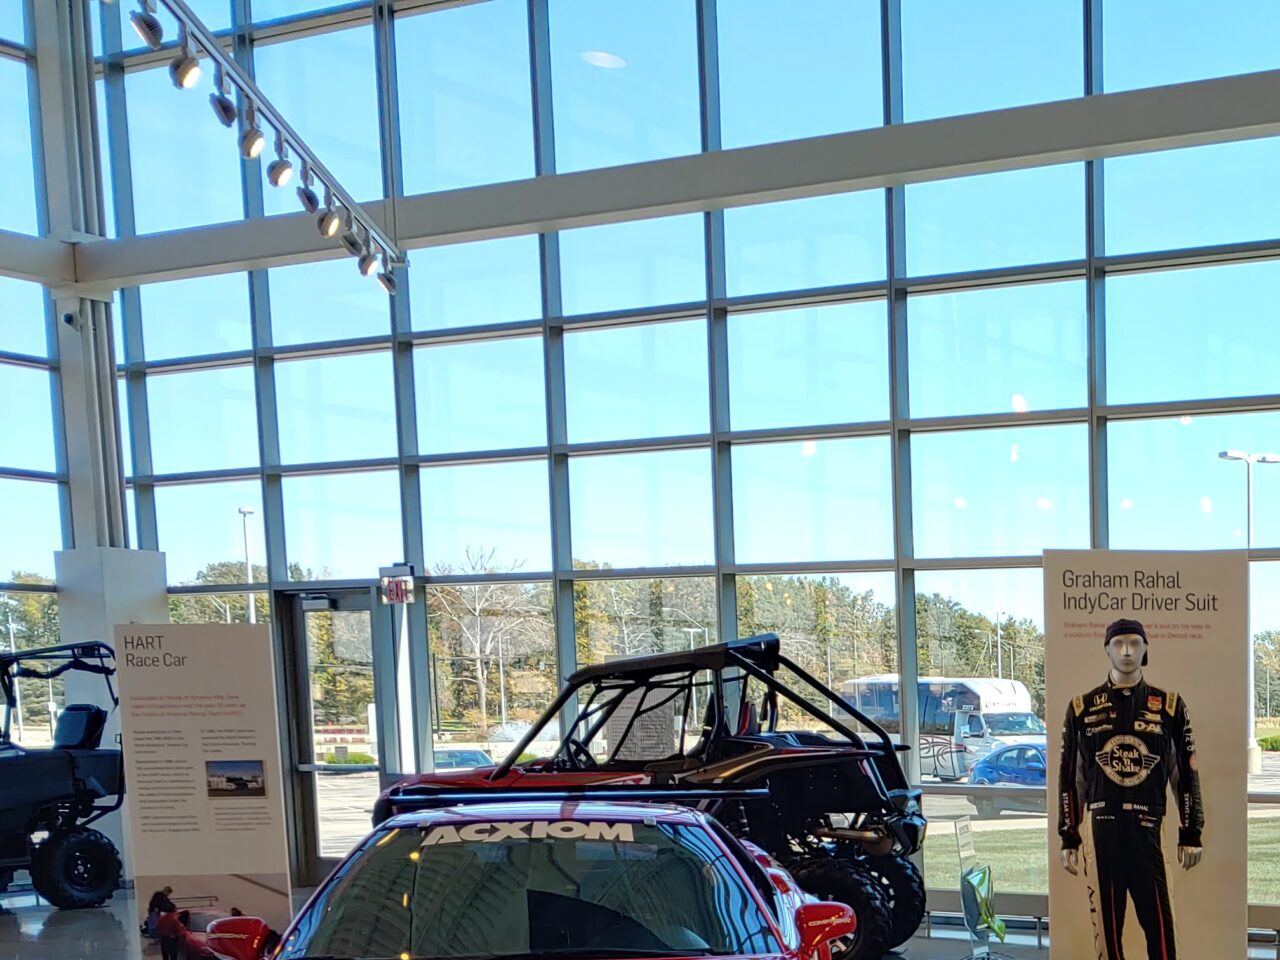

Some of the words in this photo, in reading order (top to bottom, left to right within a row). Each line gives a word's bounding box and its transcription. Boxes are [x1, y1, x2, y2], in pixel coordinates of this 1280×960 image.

[1062, 570, 1129, 589] Graham
[1134, 571, 1182, 589] Rahal
[1063, 592, 1127, 614] IndyCar
[1132, 592, 1181, 611] Driver
[1185, 593, 1218, 612] Suit
[124, 635, 165, 651] HART
[125, 652, 160, 668] Race
[163, 652, 187, 668] Car
[1113, 745, 1139, 759] Steak
[1112, 759, 1140, 773] Shake
[421, 820, 635, 847] ACXIOM
